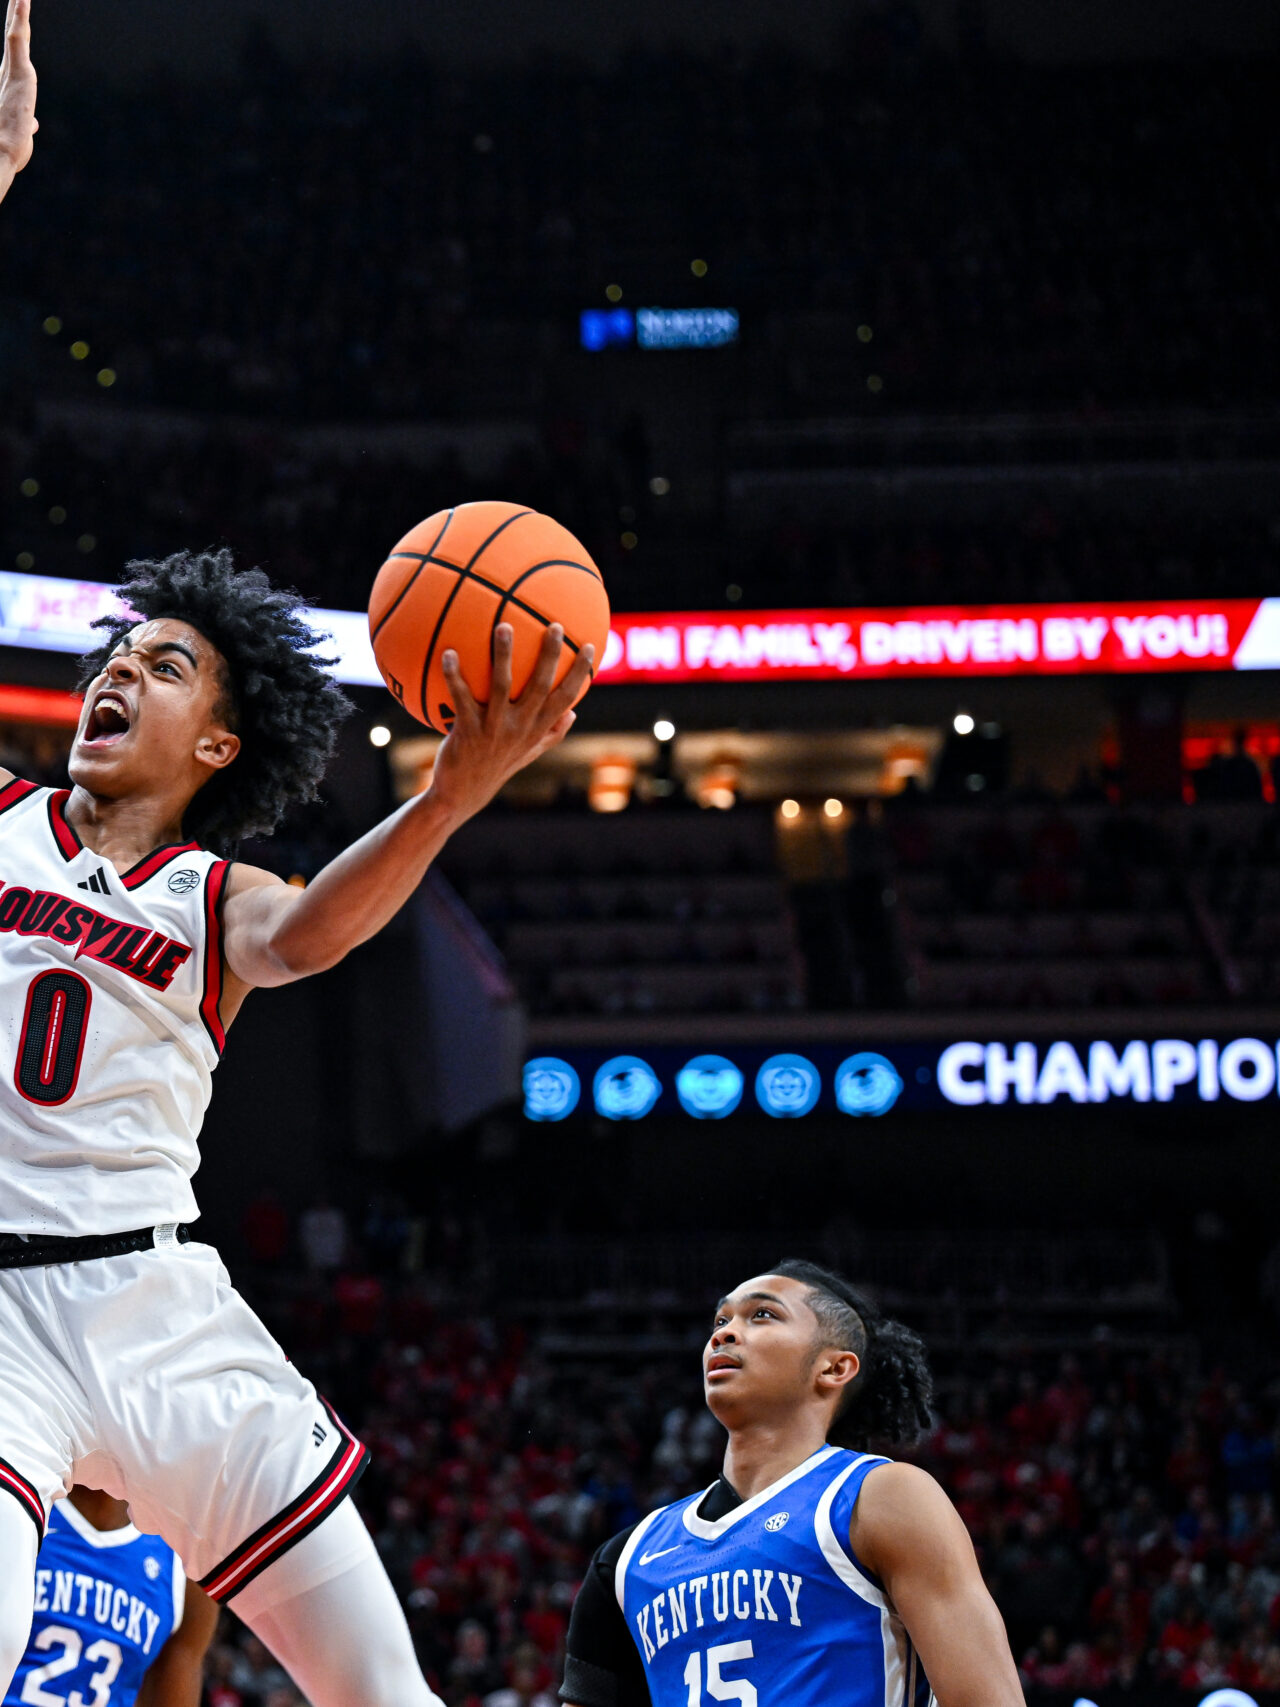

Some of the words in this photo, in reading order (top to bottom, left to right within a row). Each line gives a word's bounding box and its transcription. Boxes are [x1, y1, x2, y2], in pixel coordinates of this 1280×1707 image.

[626, 626, 680, 670] IN
[683, 622, 858, 672] FAMILY,
[860, 617, 1039, 665] DRIVEN
[1042, 617, 1109, 661] BY
[1112, 613, 1230, 660] YOU!
[14, 968, 93, 1107] 0
[936, 1036, 1280, 1106] CHAMPIO
[34, 1569, 161, 1655] ENTUCKY
[636, 1568, 803, 1665] KENTUCKY
[20, 1624, 124, 1707] 23
[683, 1639, 758, 1707] 15
